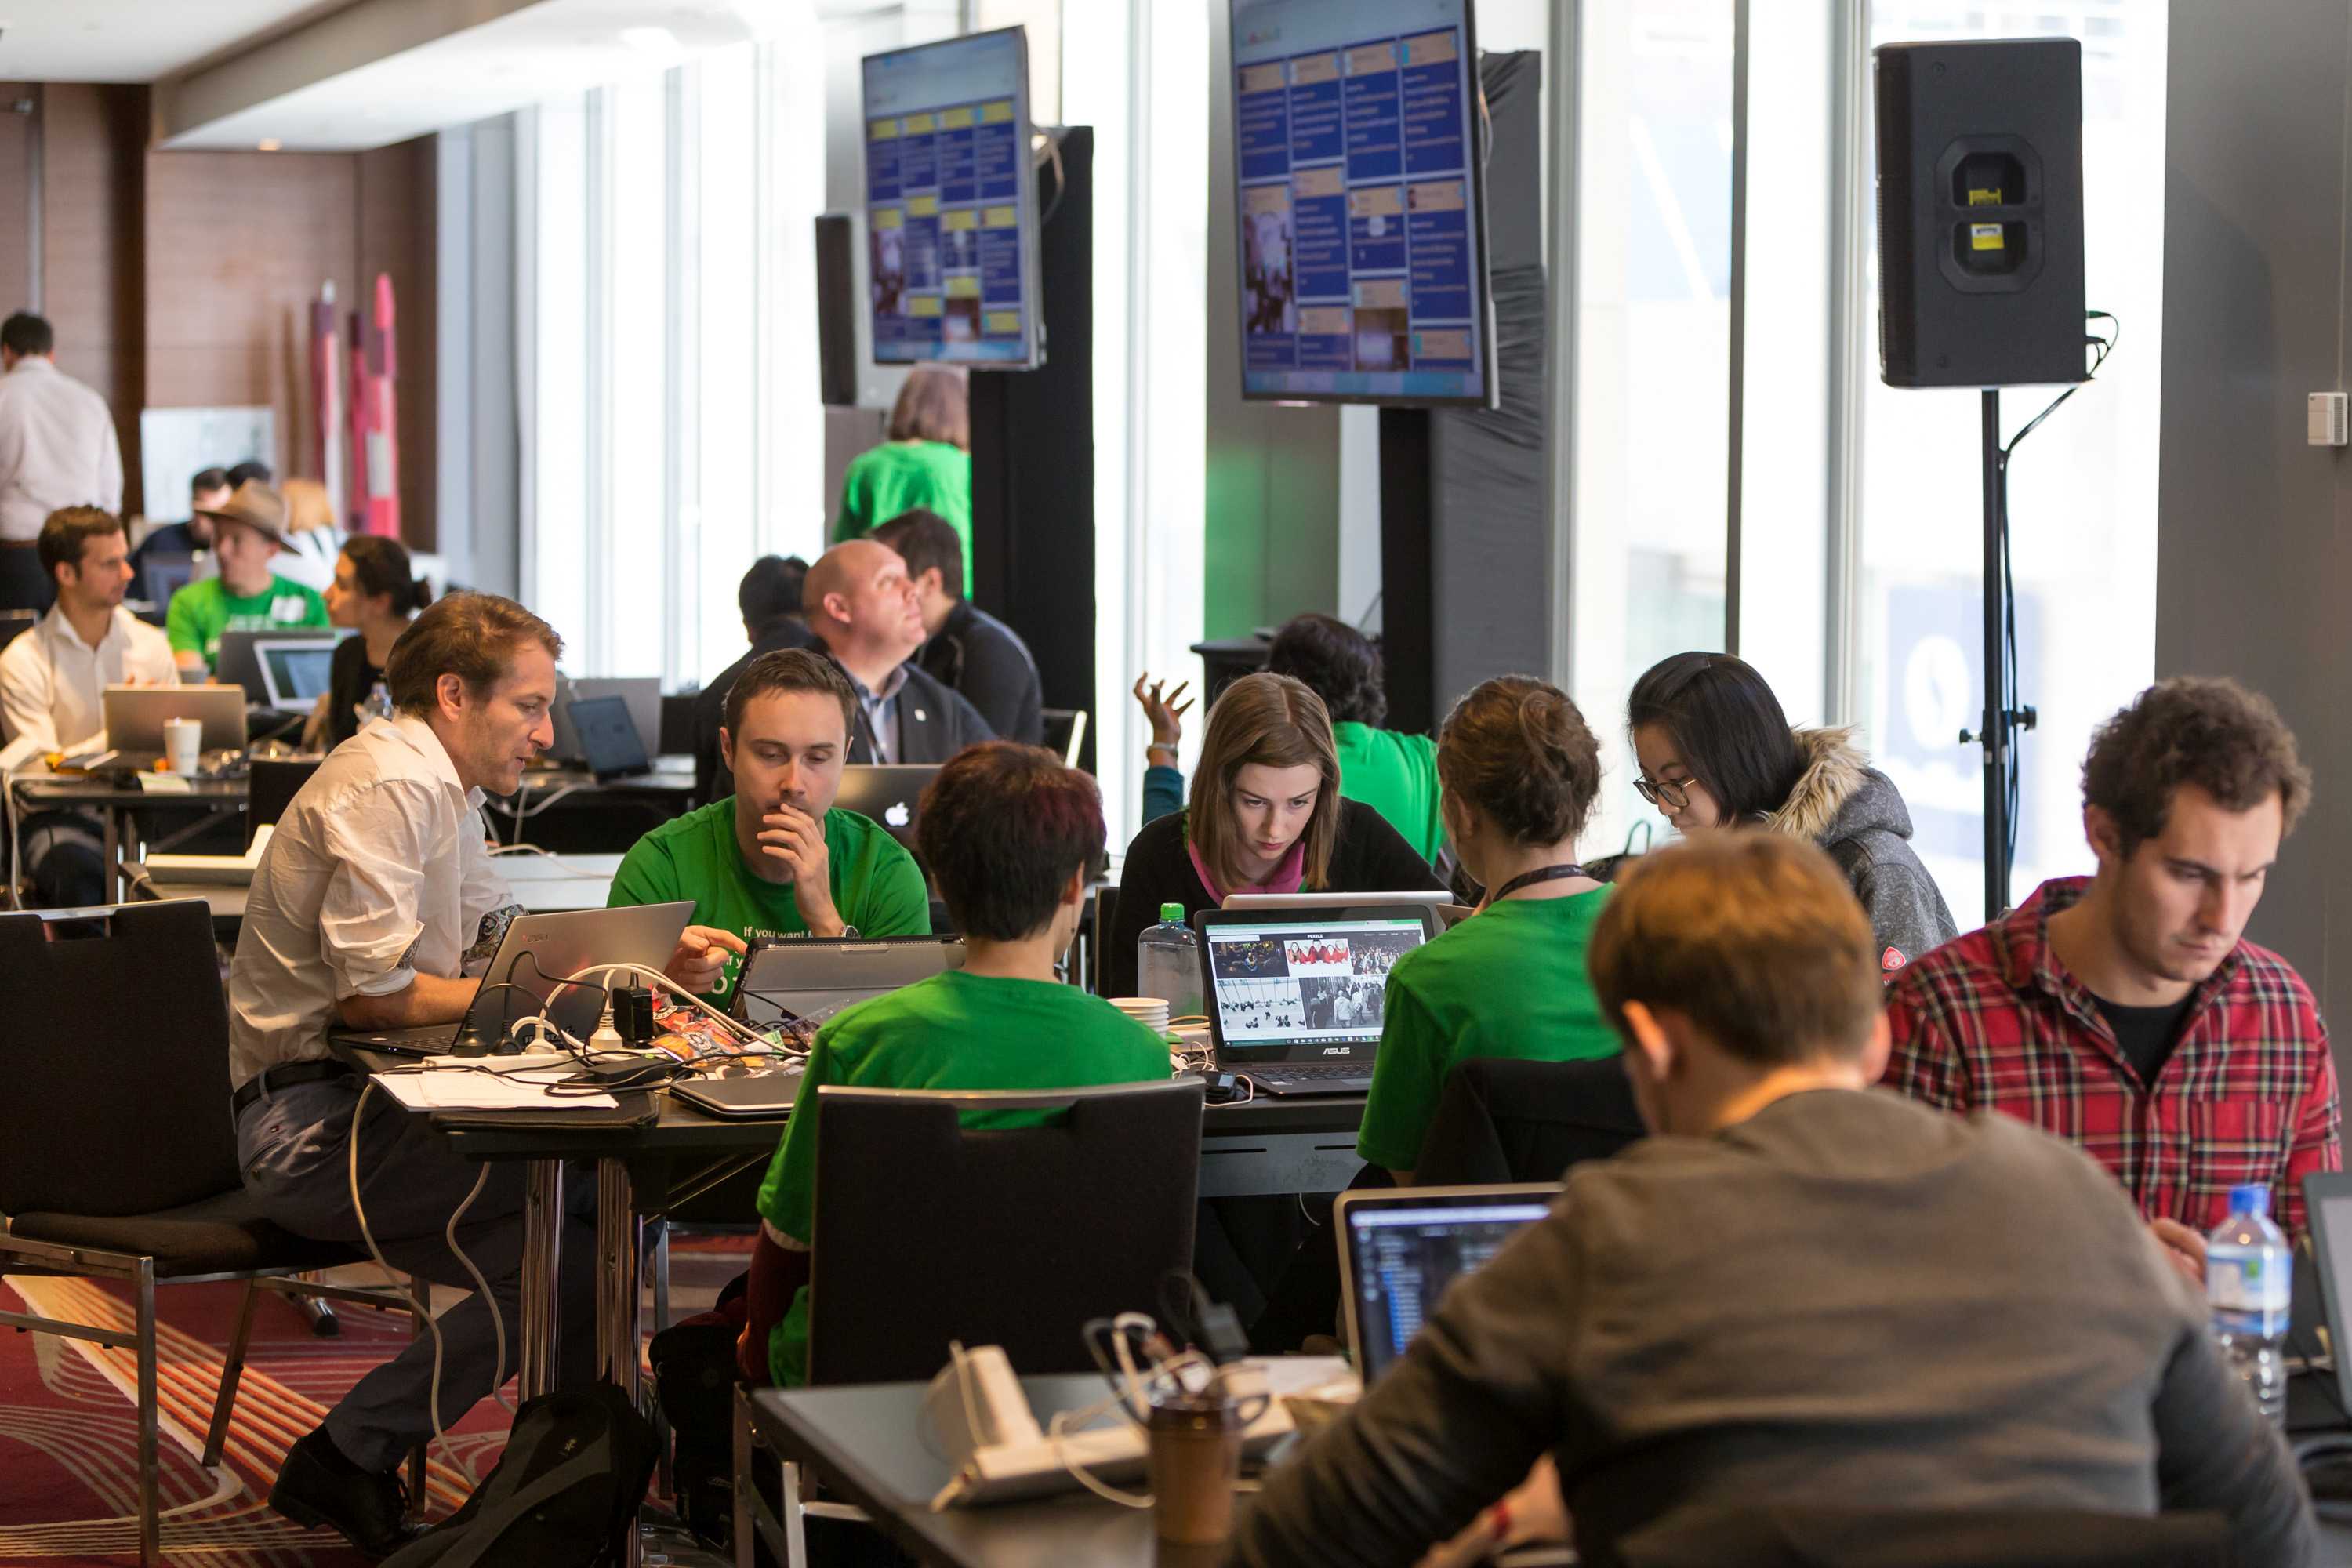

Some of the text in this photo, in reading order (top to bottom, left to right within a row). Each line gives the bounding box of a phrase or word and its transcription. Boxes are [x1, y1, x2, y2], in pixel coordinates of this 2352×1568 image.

[744, 926, 753, 937] If
[755, 929, 775, 938] you
[1323, 1047, 1350, 1055] ASUS
